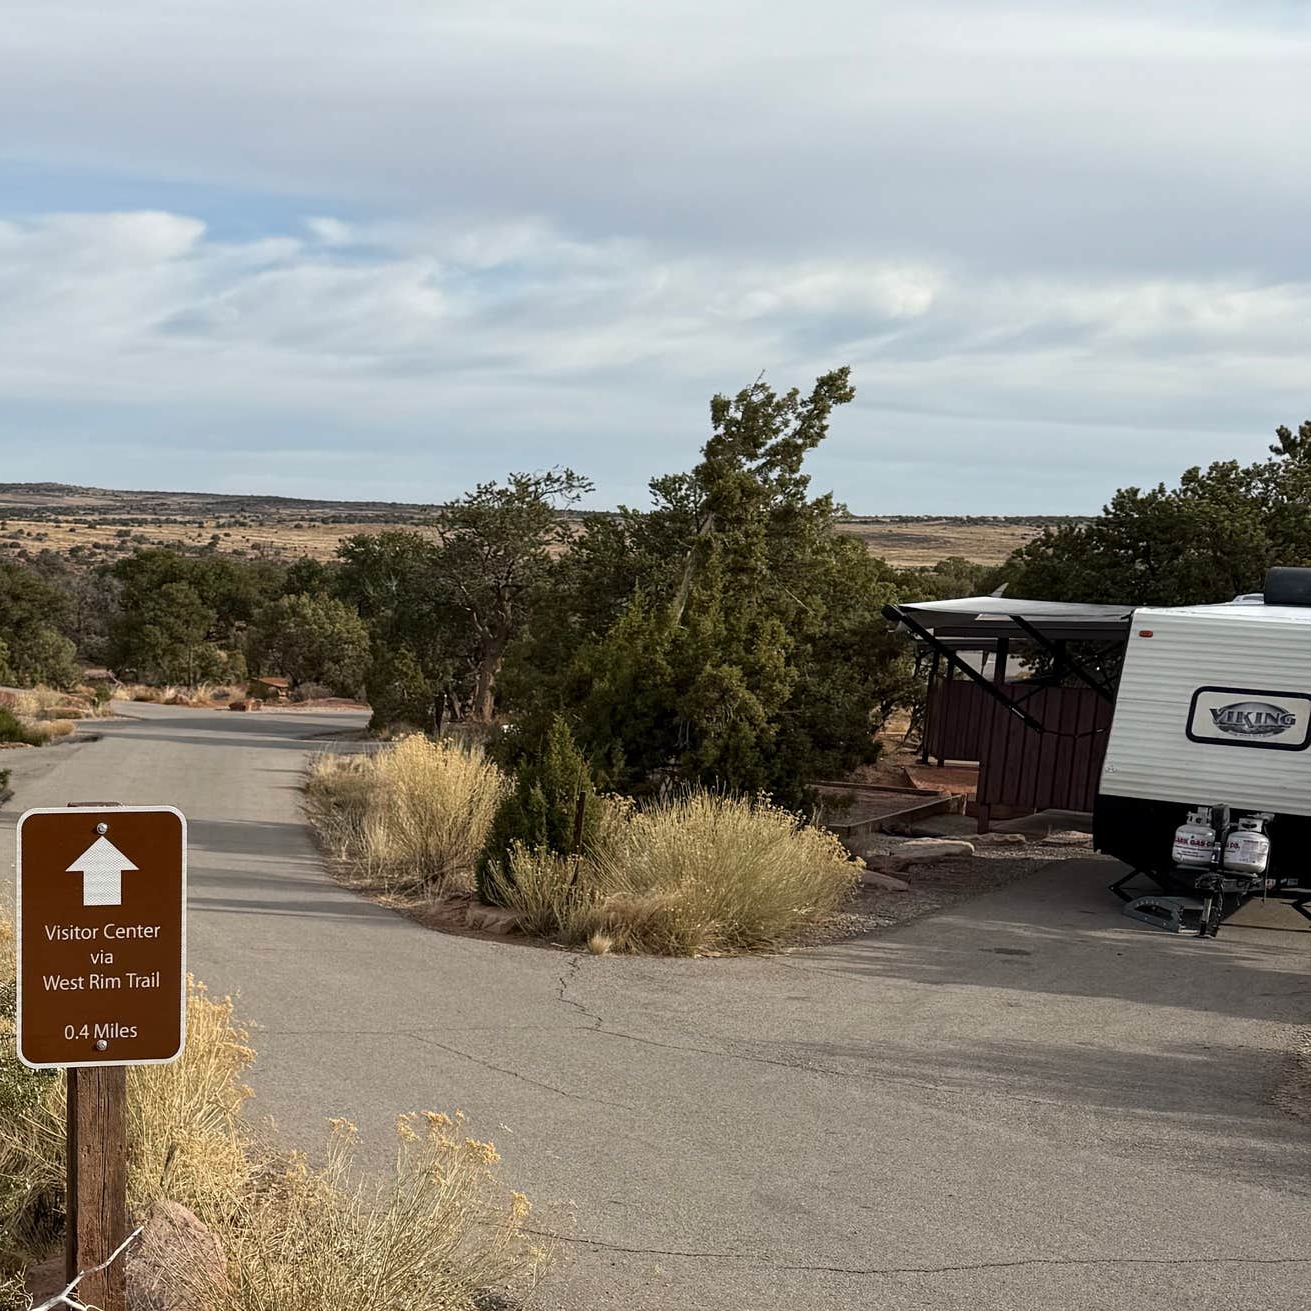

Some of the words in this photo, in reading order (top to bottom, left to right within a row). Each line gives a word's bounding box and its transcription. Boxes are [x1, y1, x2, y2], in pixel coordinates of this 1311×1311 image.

[1209, 708, 1297, 728] VIKING
[44, 924, 99, 941] Visitor
[103, 923, 161, 940] Center
[90, 949, 114, 965] via
[42, 974, 85, 991] West
[89, 973, 121, 990] Rim
[125, 971, 160, 989] Trail
[64, 1024, 90, 1041] 0.4
[93, 1022, 138, 1040] Miles
